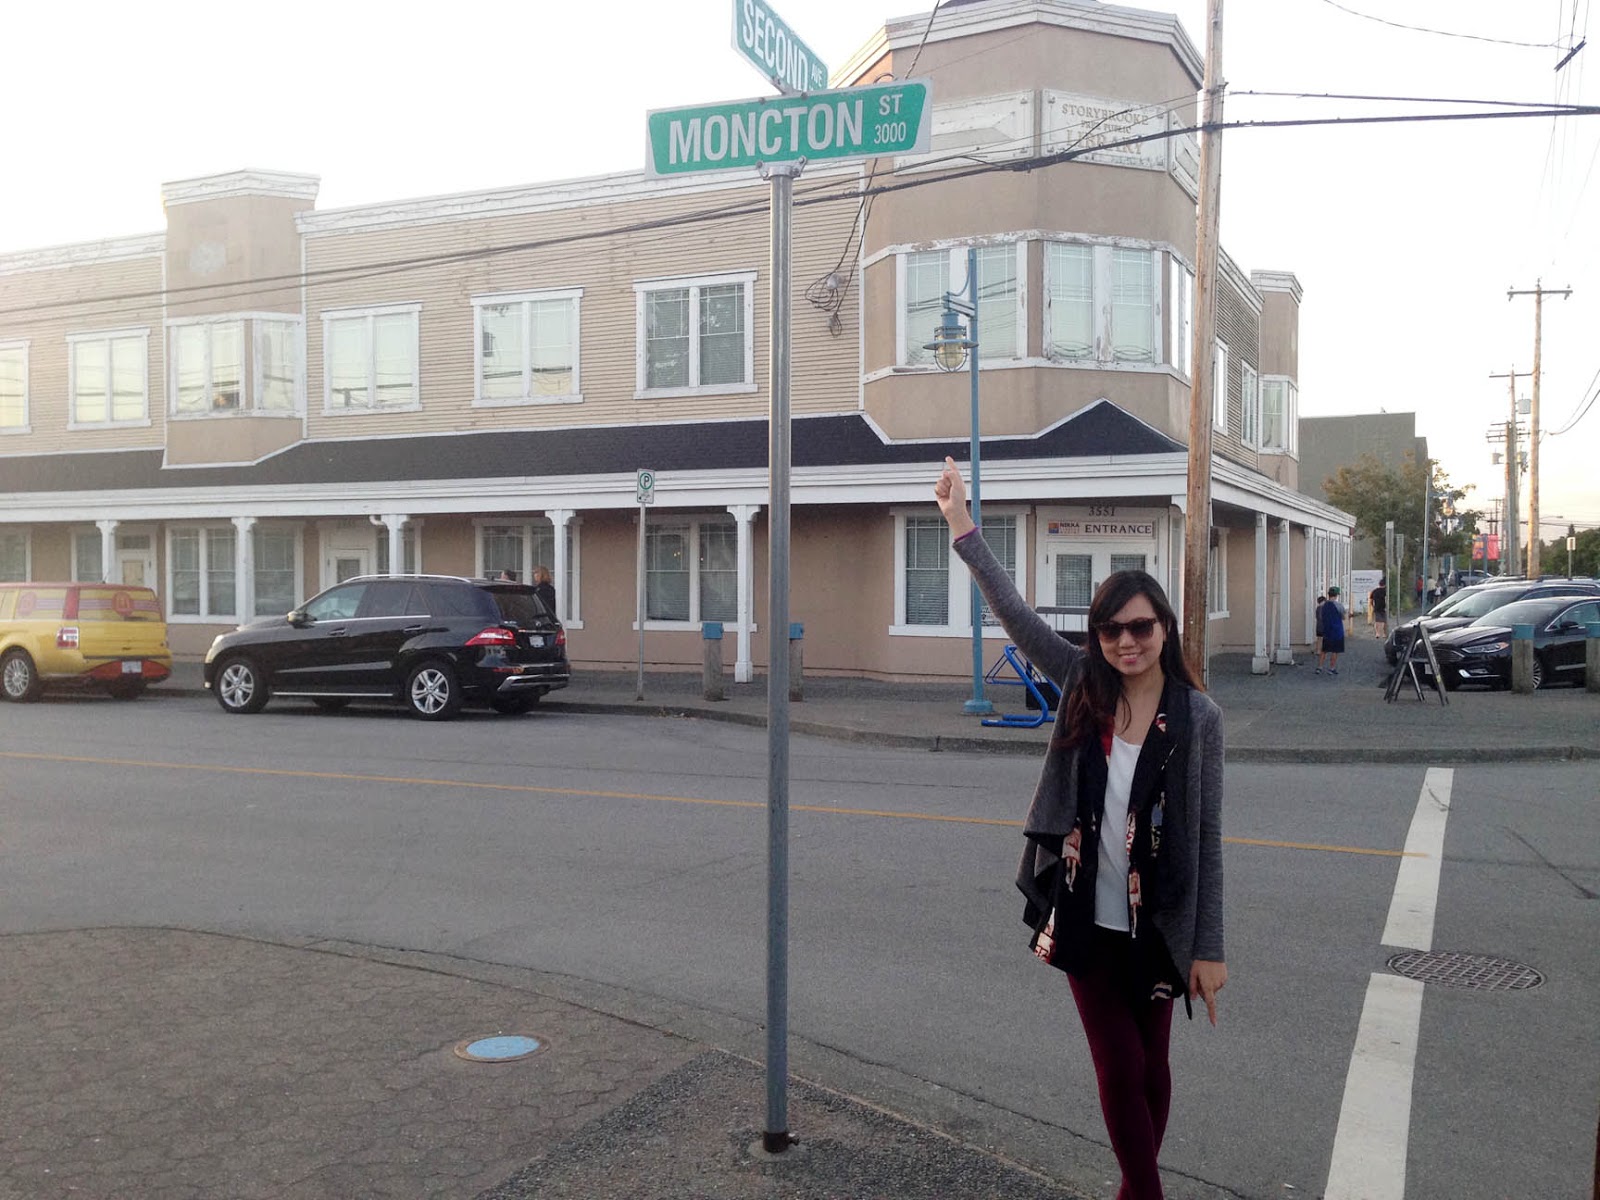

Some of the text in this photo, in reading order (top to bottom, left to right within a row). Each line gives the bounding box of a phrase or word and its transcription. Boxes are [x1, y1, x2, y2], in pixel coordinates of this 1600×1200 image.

[742, 0, 822, 92] SECOND AVE
[1062, 103, 1149, 126] STORYBROOKE
[668, 93, 903, 165] MONCTON ST
[874, 121, 906, 145] 3000
[1088, 505, 1115, 517] 3551
[1085, 524, 1152, 534] ENTRANCE
